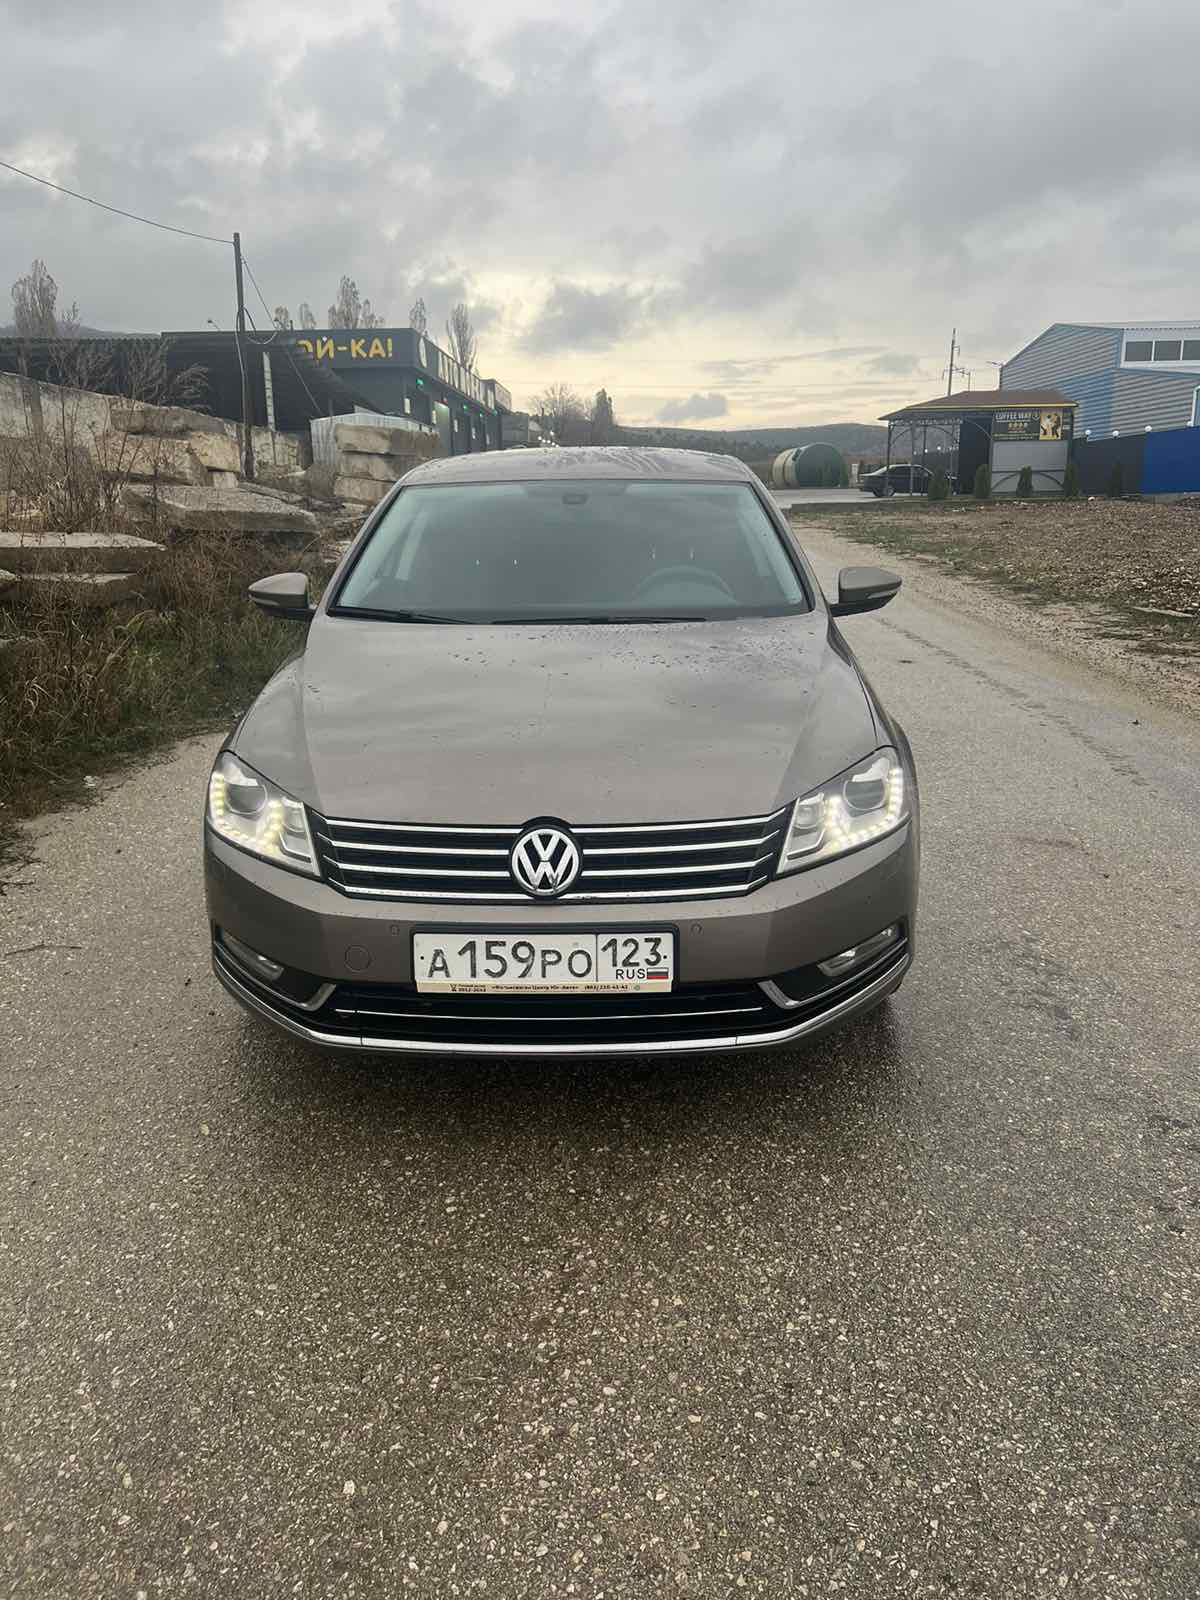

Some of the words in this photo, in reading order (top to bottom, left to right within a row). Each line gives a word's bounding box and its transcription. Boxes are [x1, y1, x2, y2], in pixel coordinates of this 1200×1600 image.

[427, 940, 593, 978] А159РО
[601, 937, 662, 967] 123
[616, 968, 646, 980] RUS
